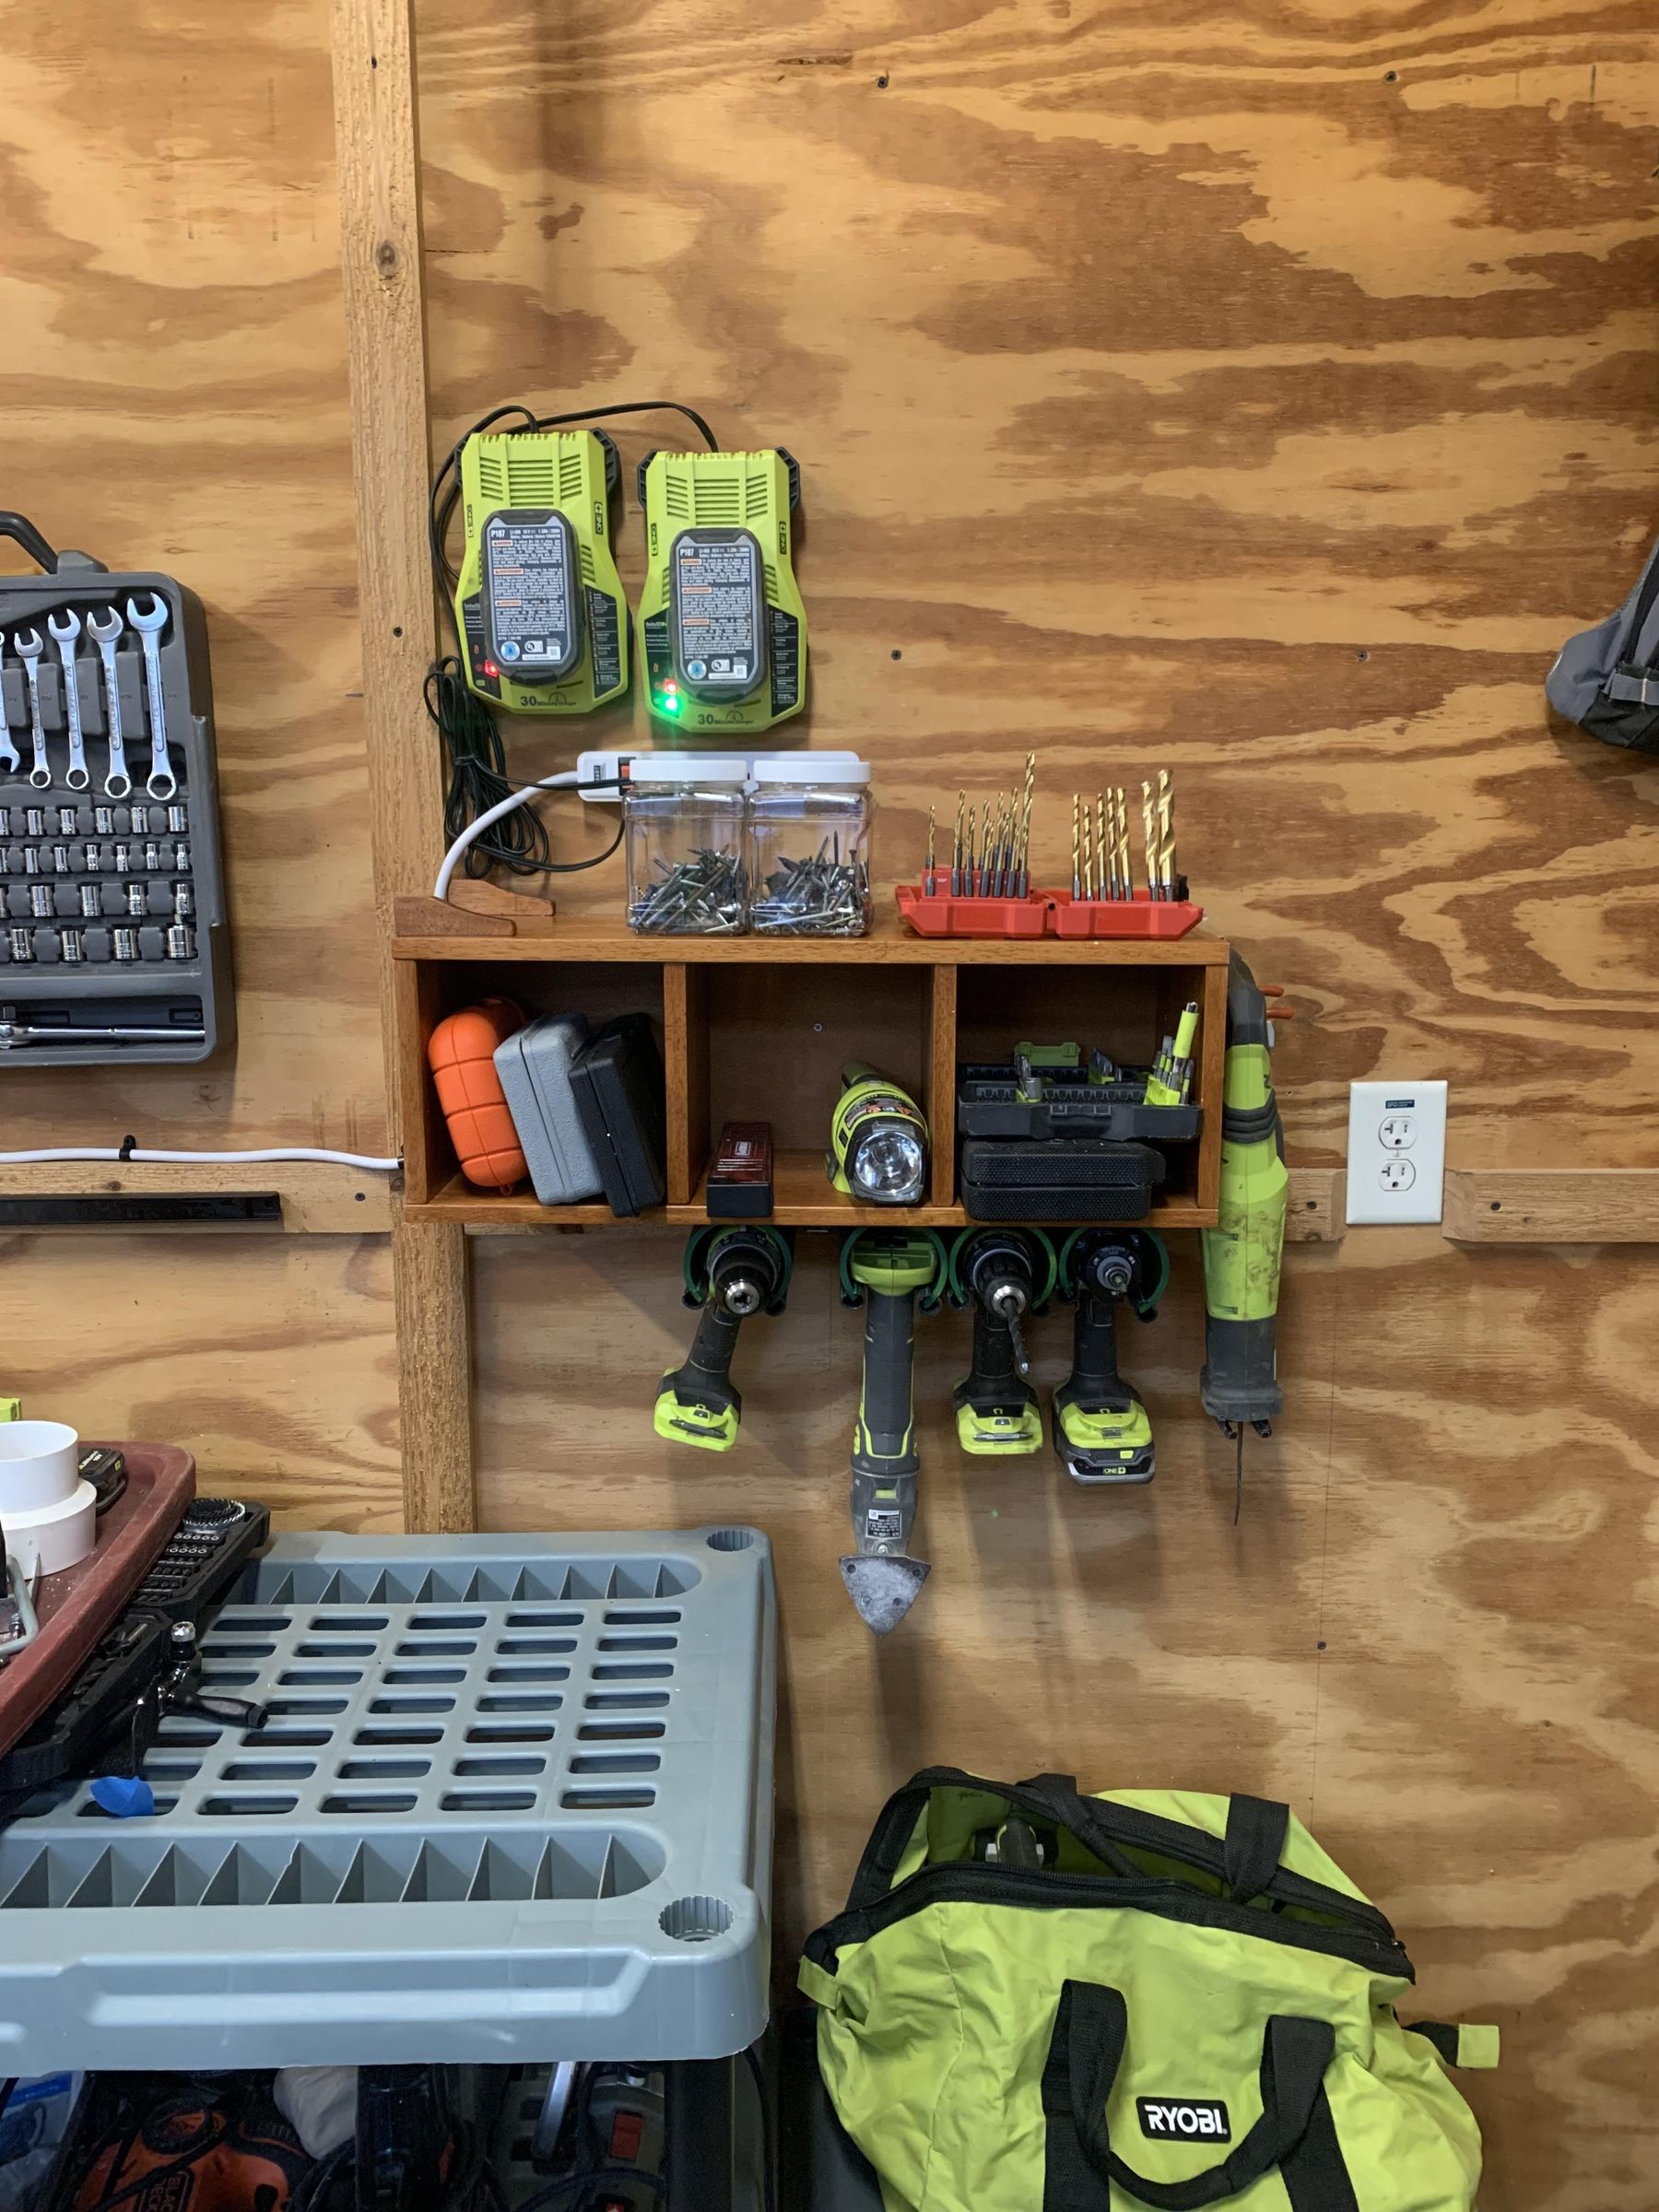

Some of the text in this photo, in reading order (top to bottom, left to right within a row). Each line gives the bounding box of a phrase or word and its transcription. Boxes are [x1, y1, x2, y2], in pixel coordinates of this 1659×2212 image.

[520, 696, 536, 706] 30
[698, 713, 714, 724] 30
[1144, 2104, 1223, 2135] RYOBI
